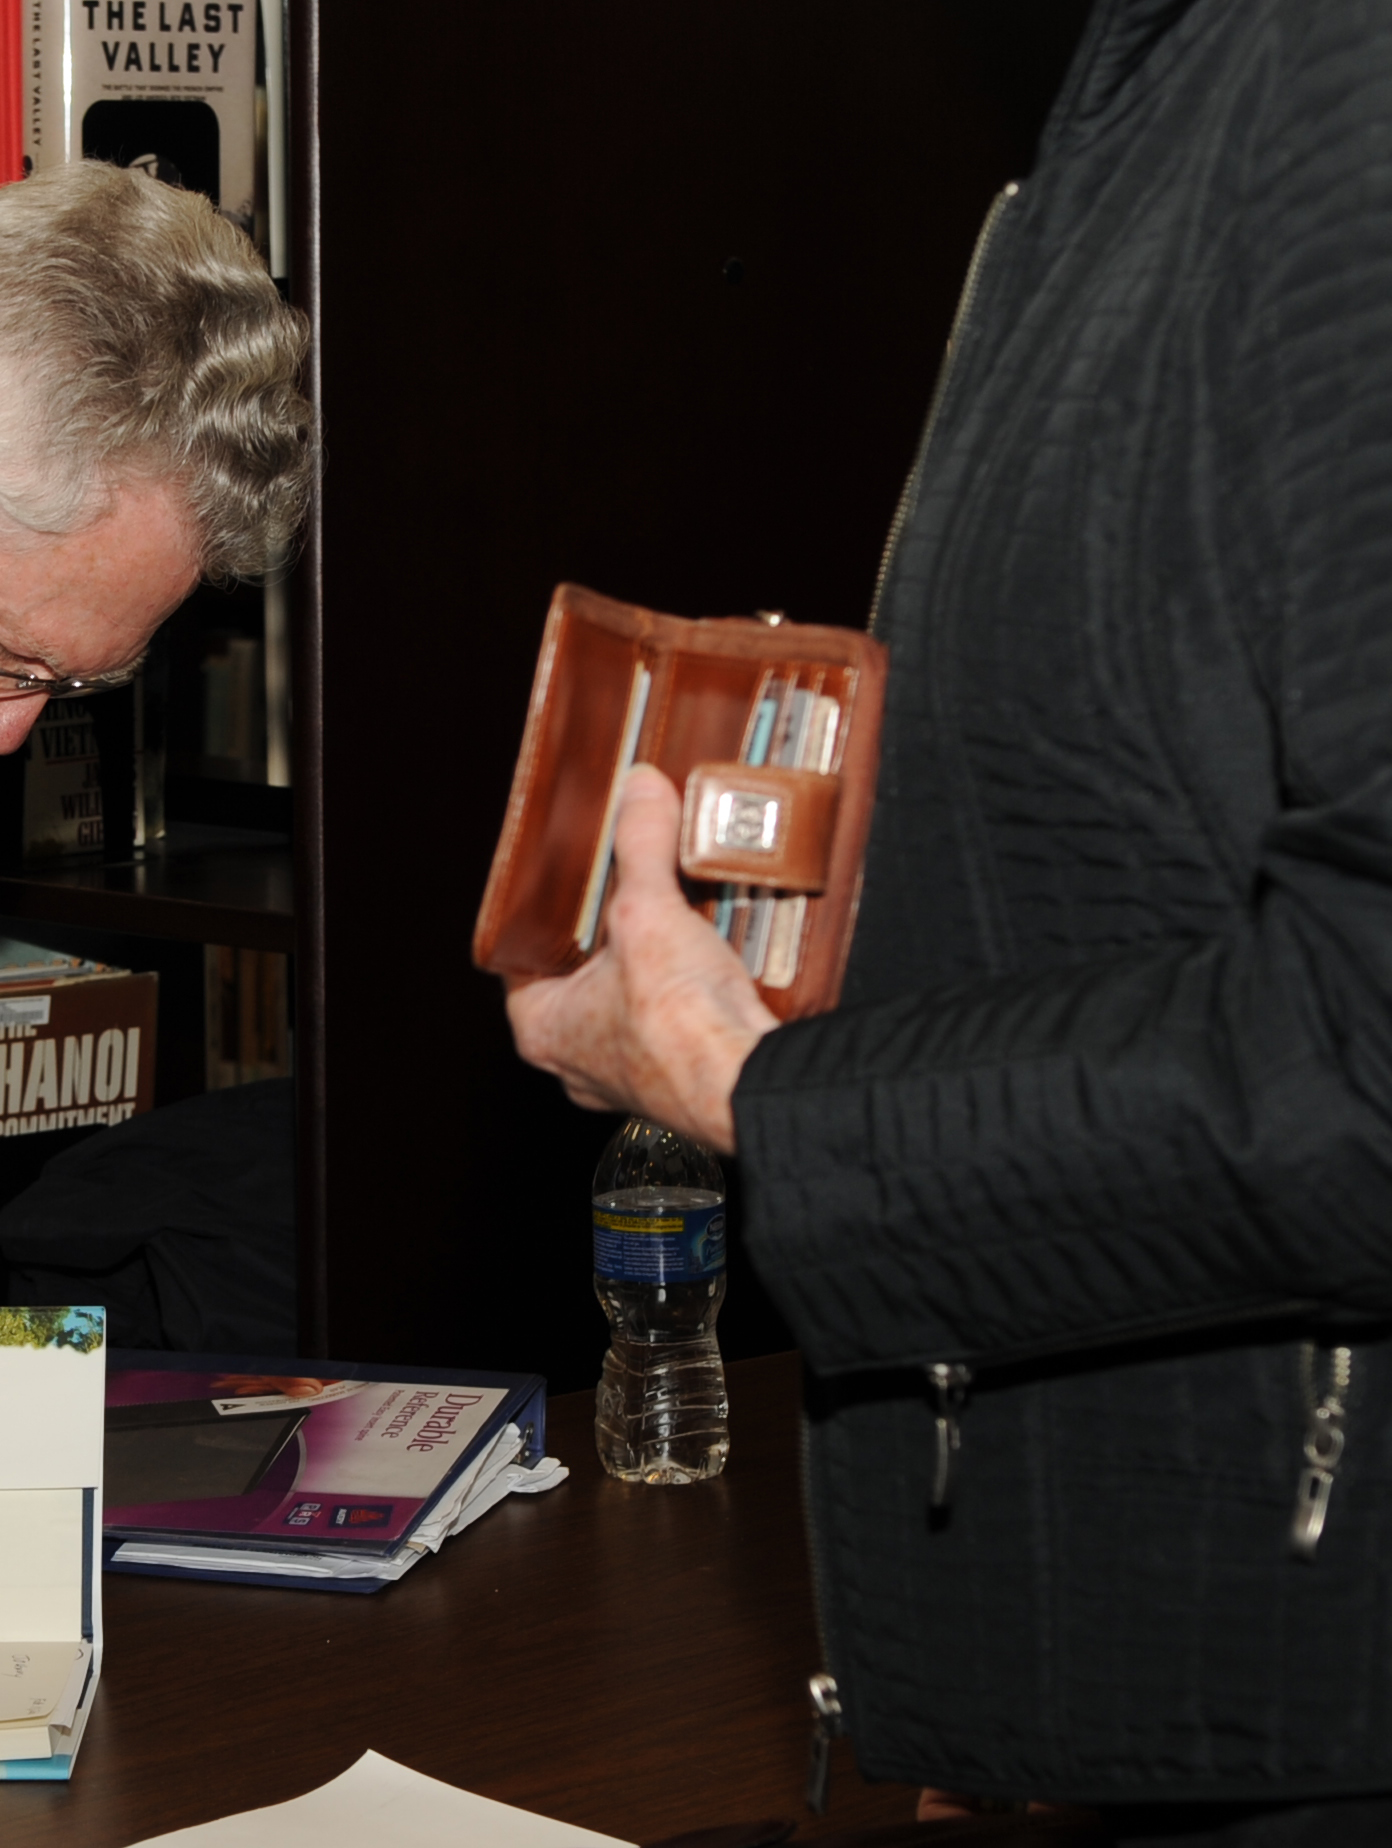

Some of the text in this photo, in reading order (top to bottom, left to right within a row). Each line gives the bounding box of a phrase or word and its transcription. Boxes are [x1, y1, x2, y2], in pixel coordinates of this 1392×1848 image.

[82, 0, 244, 34] THE LAST
[31, 1, 43, 147] THE LAST VALLEY
[101, 40, 226, 74] VALLEY
[381, 1391, 439, 1438] Reference
[406, 1393, 484, 1452] Durable
